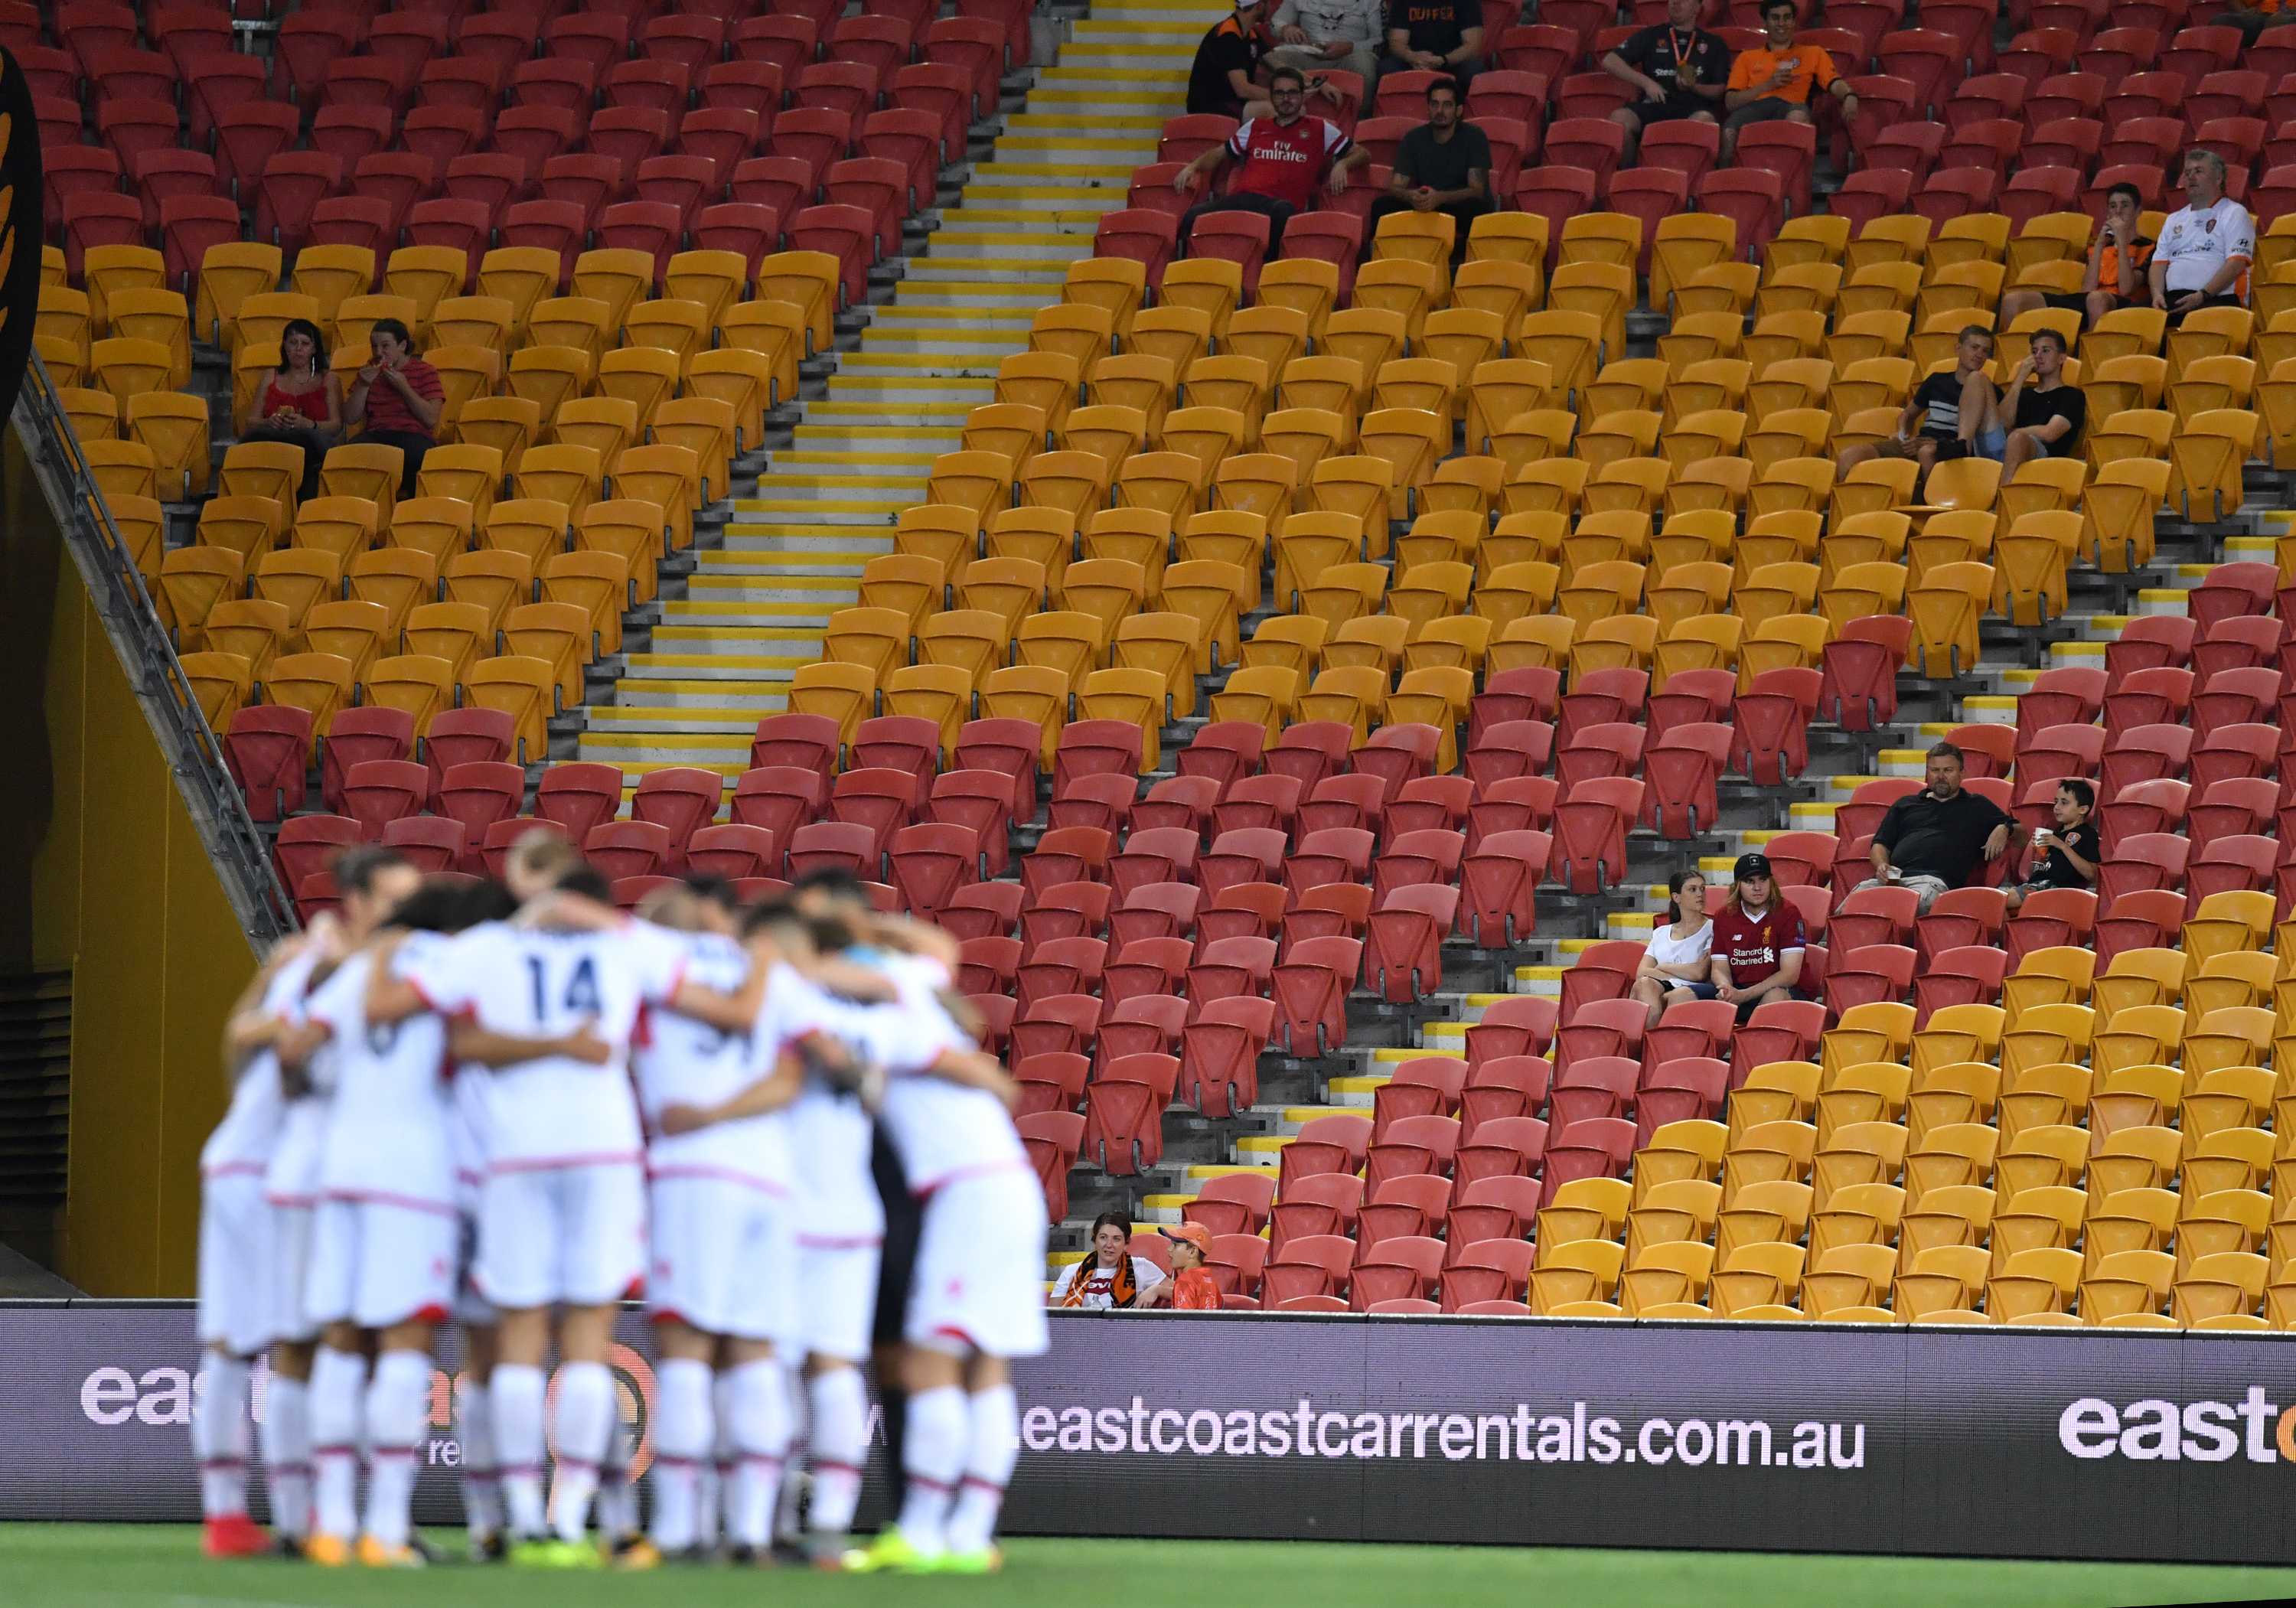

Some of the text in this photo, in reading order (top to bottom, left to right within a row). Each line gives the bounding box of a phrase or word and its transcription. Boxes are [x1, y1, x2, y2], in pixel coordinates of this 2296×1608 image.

[1274, 140, 1291, 151] Fly
[1254, 148, 1307, 163] Emirates
[1733, 947, 1763, 957] Stanrd
[1730, 956, 1763, 966] Charred
[527, 955, 602, 1020] 14
